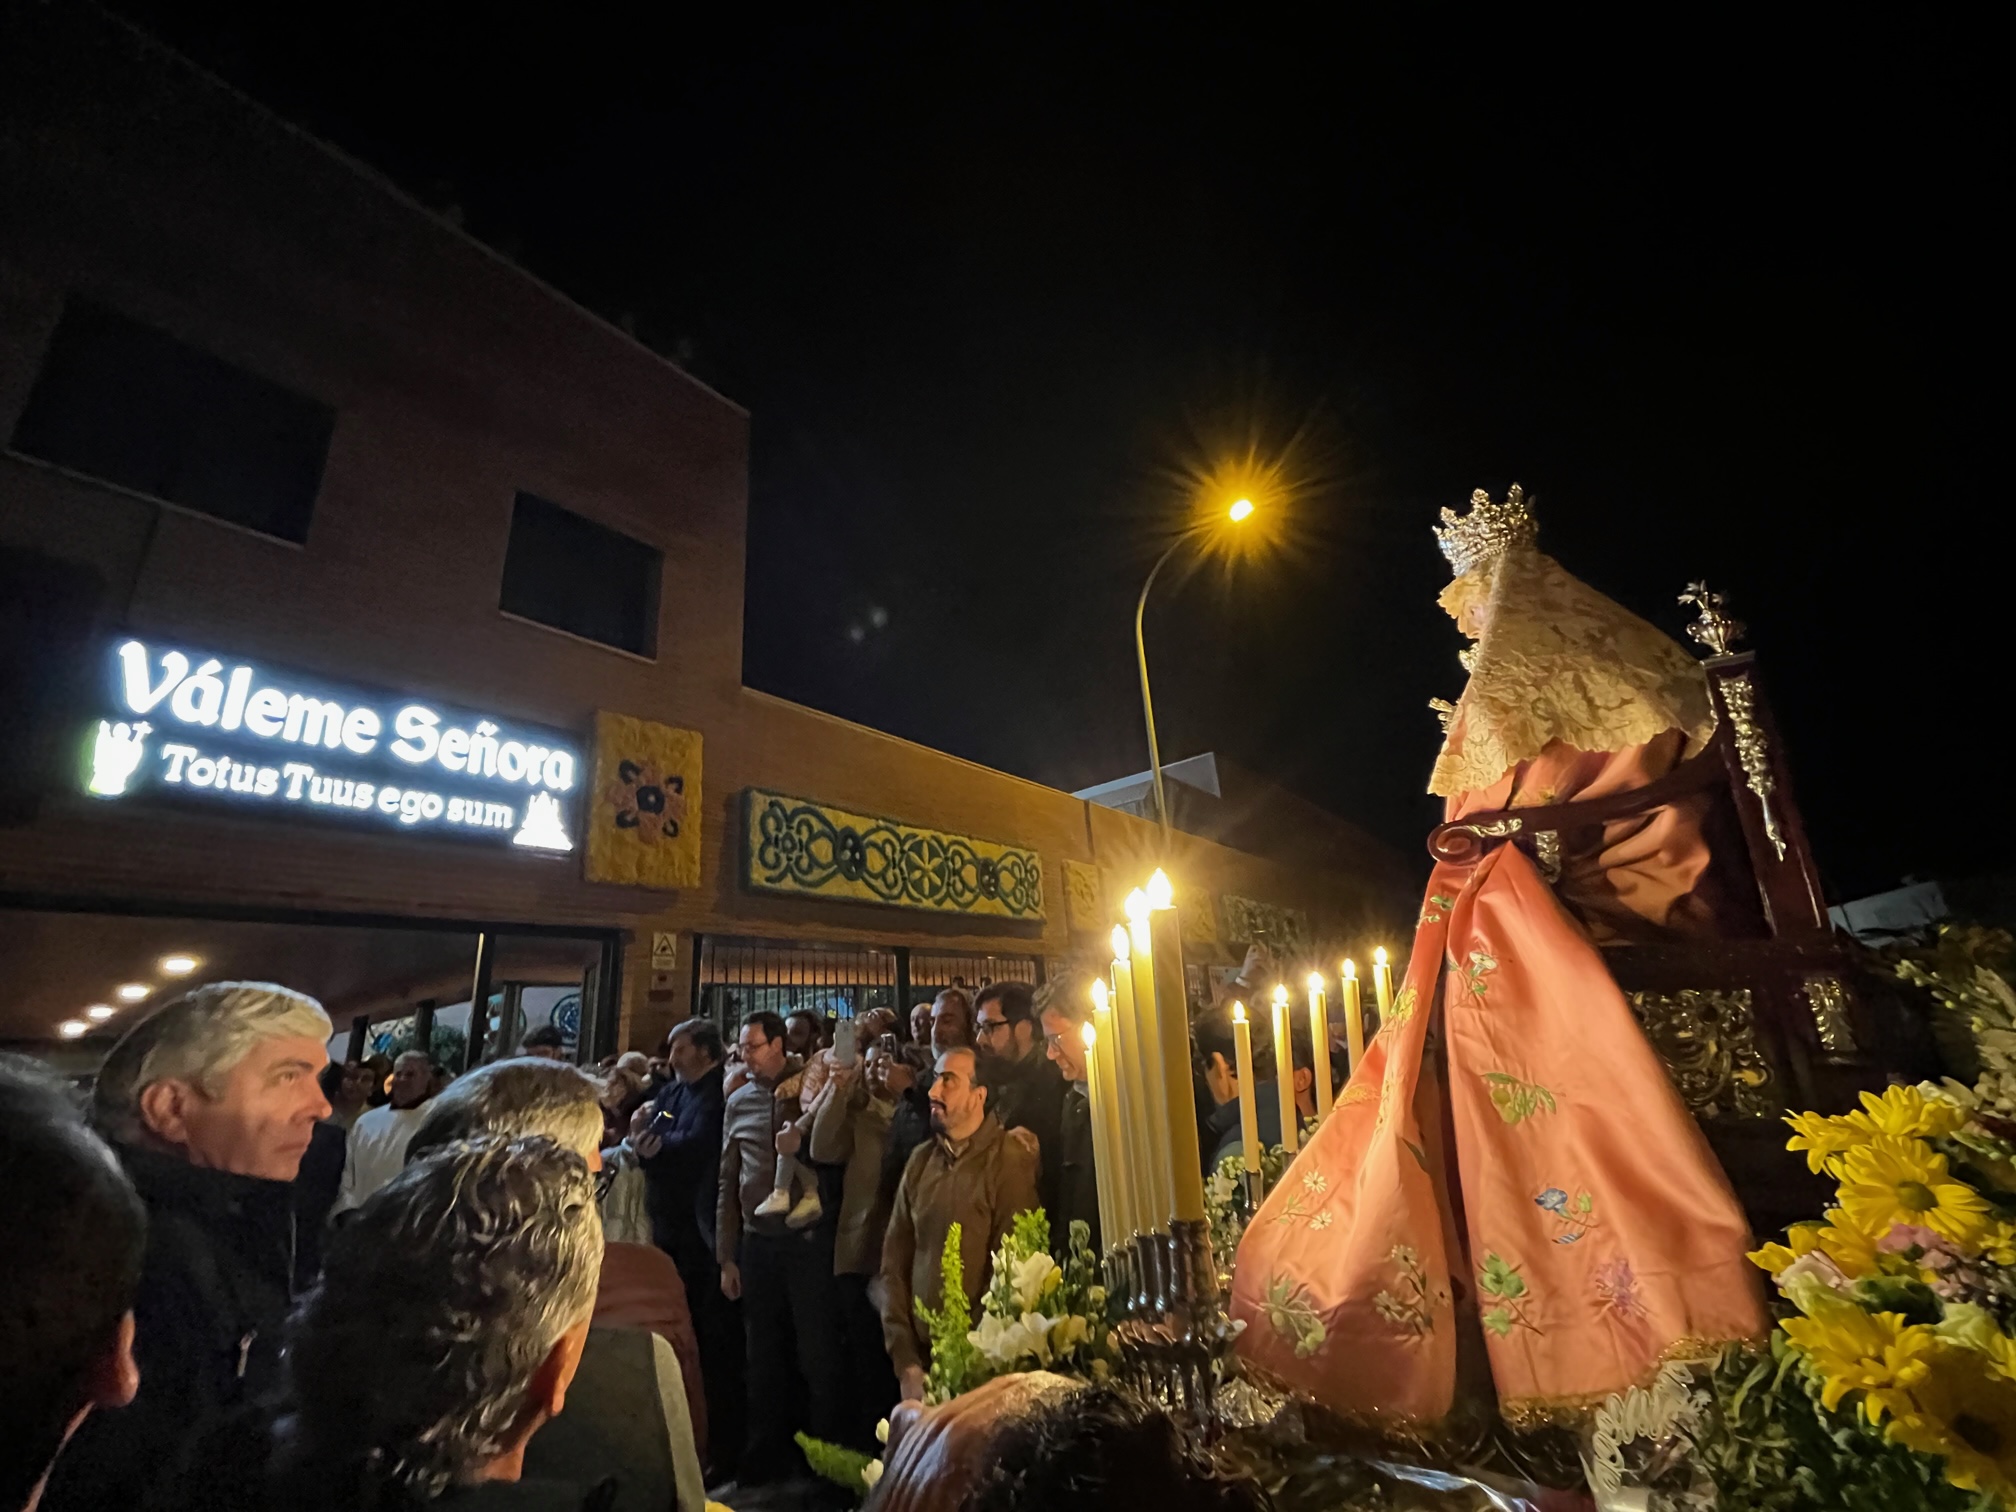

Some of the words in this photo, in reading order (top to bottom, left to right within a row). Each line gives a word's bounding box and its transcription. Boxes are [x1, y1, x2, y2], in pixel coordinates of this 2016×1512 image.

[119, 641, 382, 754] Váleme
[390, 706, 574, 791] Señora
[162, 744, 279, 795] Totus
[283, 763, 375, 809] Tuus
[377, 787, 444, 823] ego
[446, 797, 513, 829] sum
